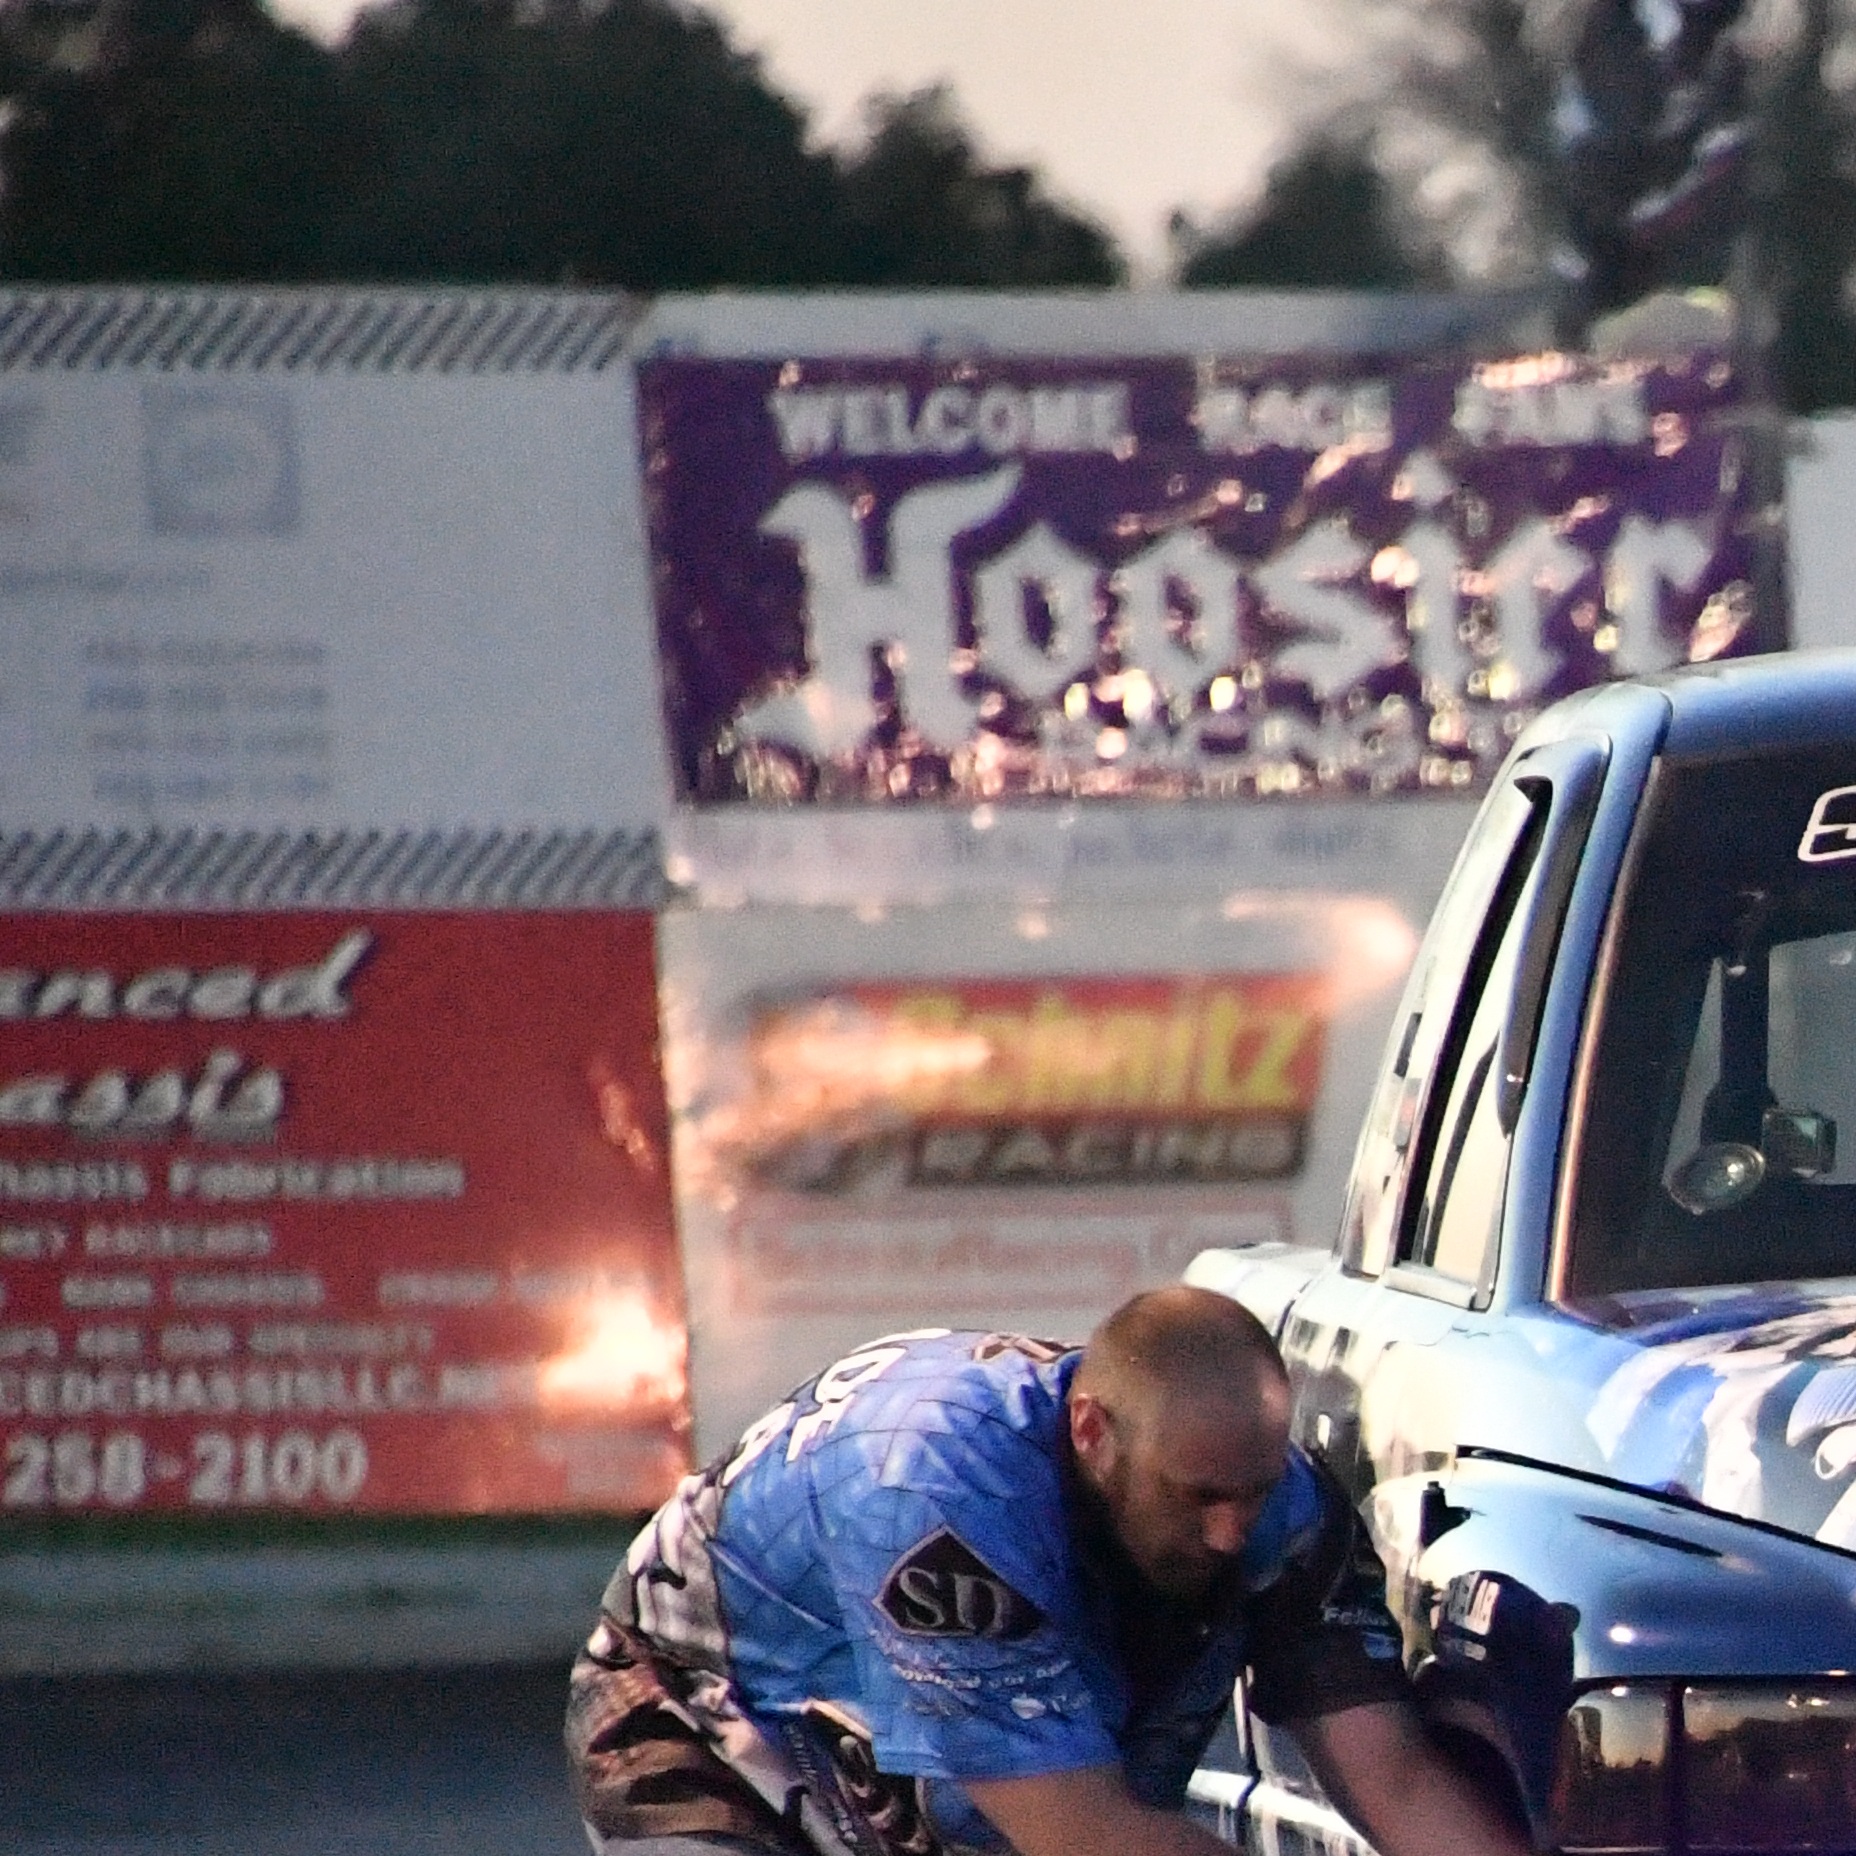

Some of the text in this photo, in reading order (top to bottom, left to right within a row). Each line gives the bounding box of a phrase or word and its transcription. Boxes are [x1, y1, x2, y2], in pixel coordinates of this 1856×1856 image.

[768, 379, 1133, 458] WELCOME
[730, 461, 1716, 765] Hoosier
[921, 1126, 1297, 1176] RACING
[4, 1430, 369, 1508] 258-2100
